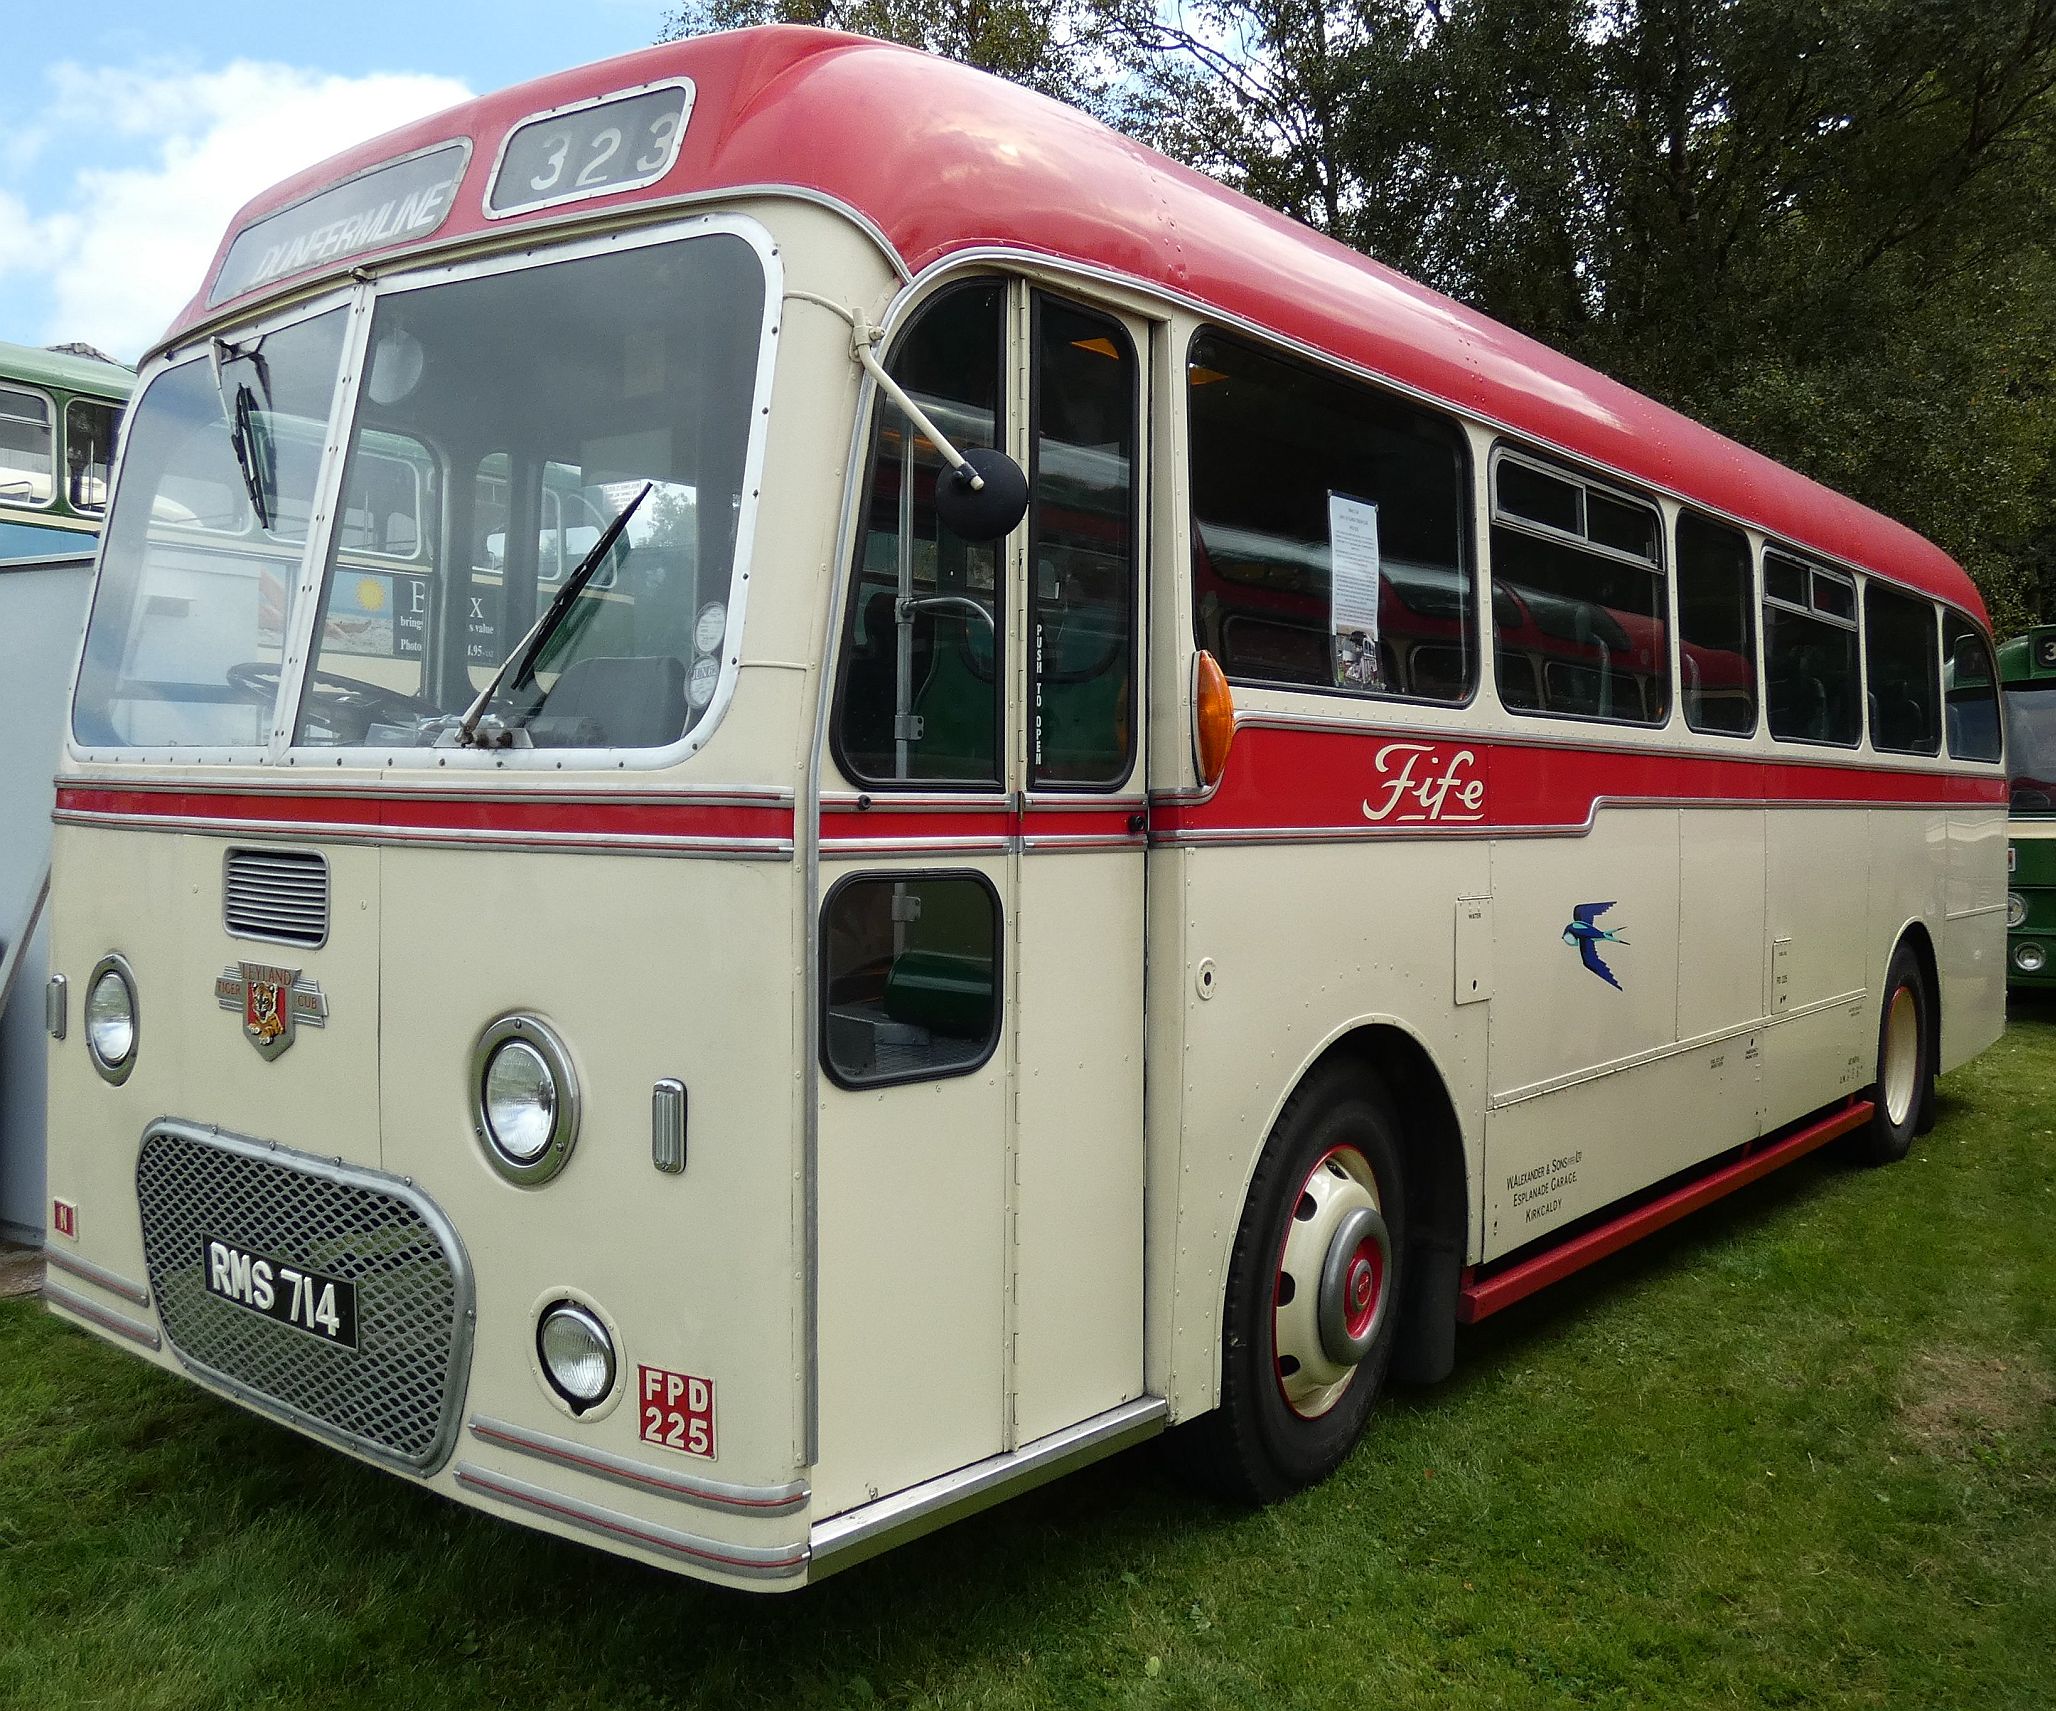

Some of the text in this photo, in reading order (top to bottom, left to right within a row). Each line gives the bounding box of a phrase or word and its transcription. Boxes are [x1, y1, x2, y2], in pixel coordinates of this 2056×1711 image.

[530, 112, 680, 190] 323
[253, 179, 451, 281] DUNFERMLINE
[1036, 683, 1042, 707] TO
[1362, 743, 1484, 821] Fife
[217, 981, 318, 1010] TIGER CUB
[242, 963, 292, 986] LEYLAND
[210, 1241, 340, 1337] RMS 714
[645, 1369, 709, 1413] FPD
[645, 1406, 709, 1454] 225
